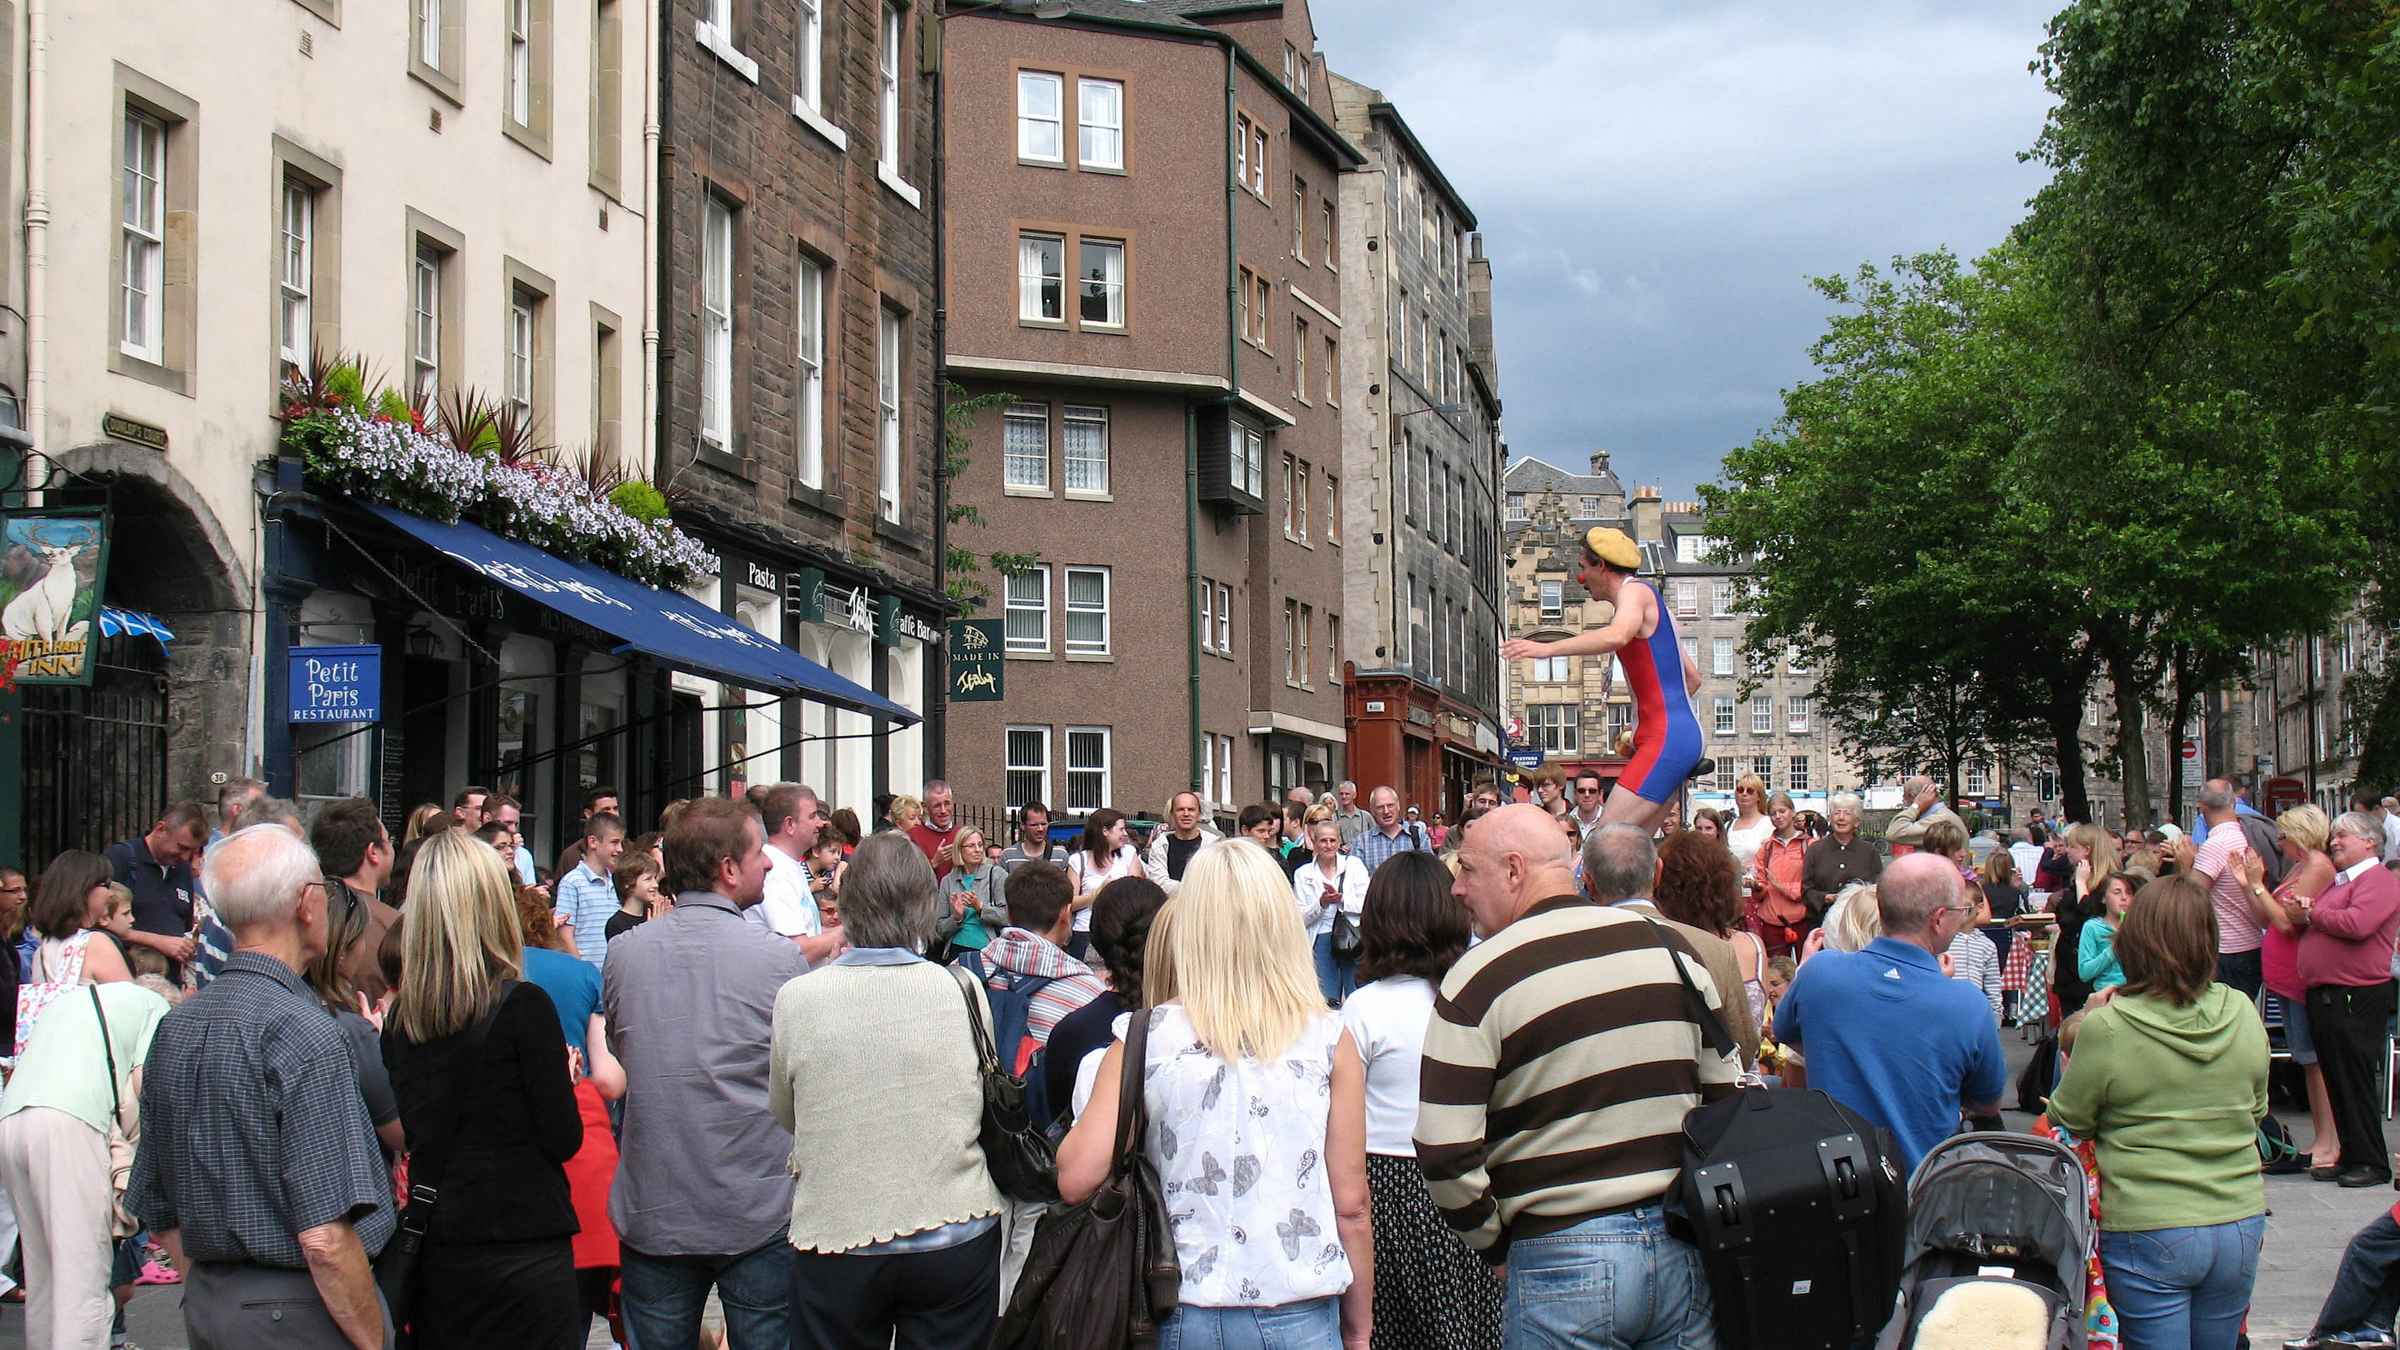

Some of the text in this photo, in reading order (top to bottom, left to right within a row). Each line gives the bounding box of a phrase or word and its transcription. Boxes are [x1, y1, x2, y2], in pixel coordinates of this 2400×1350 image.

[749, 562, 776, 591] Pasta
[917, 619, 931, 641] Bar
[27, 656, 81, 676] INN
[952, 652, 1000, 662] MADE IN
[305, 658, 360, 683] Petit
[308, 683, 360, 707] Paris
[293, 708, 375, 720] RESTAURANT
